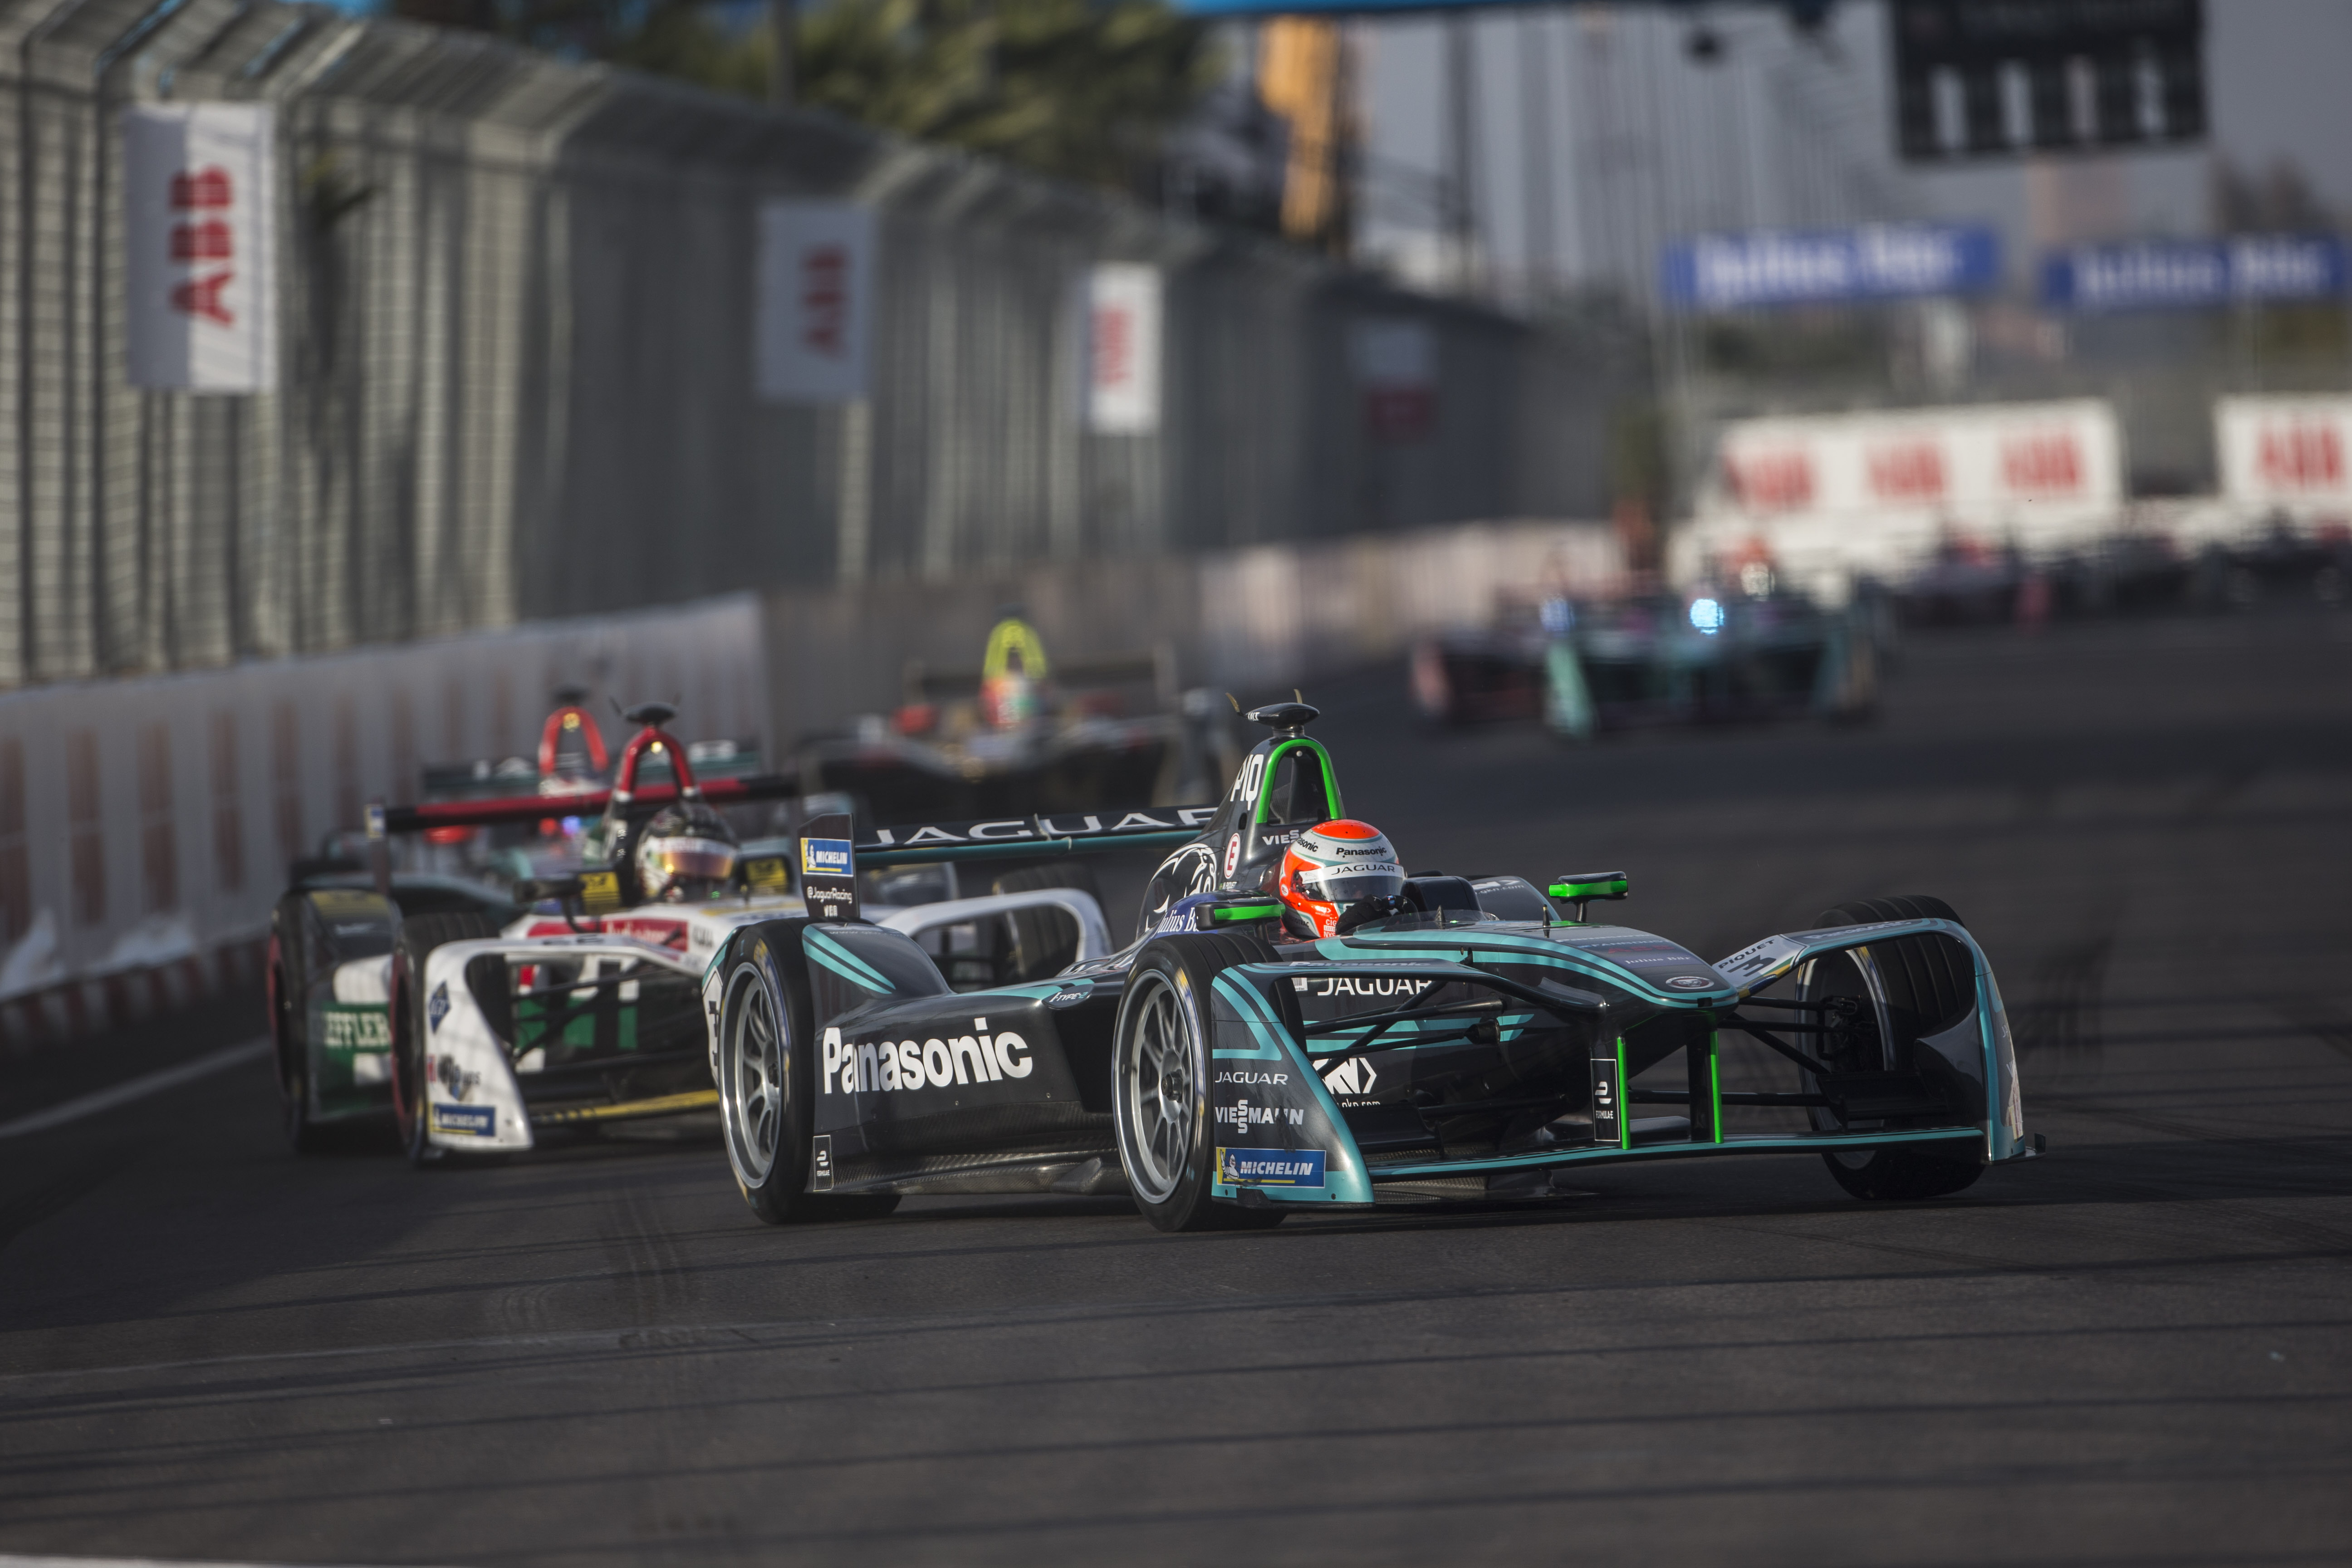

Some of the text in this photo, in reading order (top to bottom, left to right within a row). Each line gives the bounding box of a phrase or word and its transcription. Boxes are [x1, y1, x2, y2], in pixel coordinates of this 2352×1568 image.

[168, 161, 237, 329] ABB
[1262, 829, 1300, 845] VIES
[816, 850, 848, 864] MICHELIN
[1336, 846, 1387, 856] Panasonic
[1331, 864, 1395, 875] JAGUAR
[807, 886, 853, 904] @JaguarRacing
[1150, 909, 1186, 939] Julius
[1804, 921, 1912, 940] Panasonic
[1718, 939, 1775, 970] PIQUET
[823, 1017, 1033, 1094] Panasonic
[1215, 1071, 1289, 1085] JAGUAR
[1240, 1161, 1313, 1176] MICHELIN
